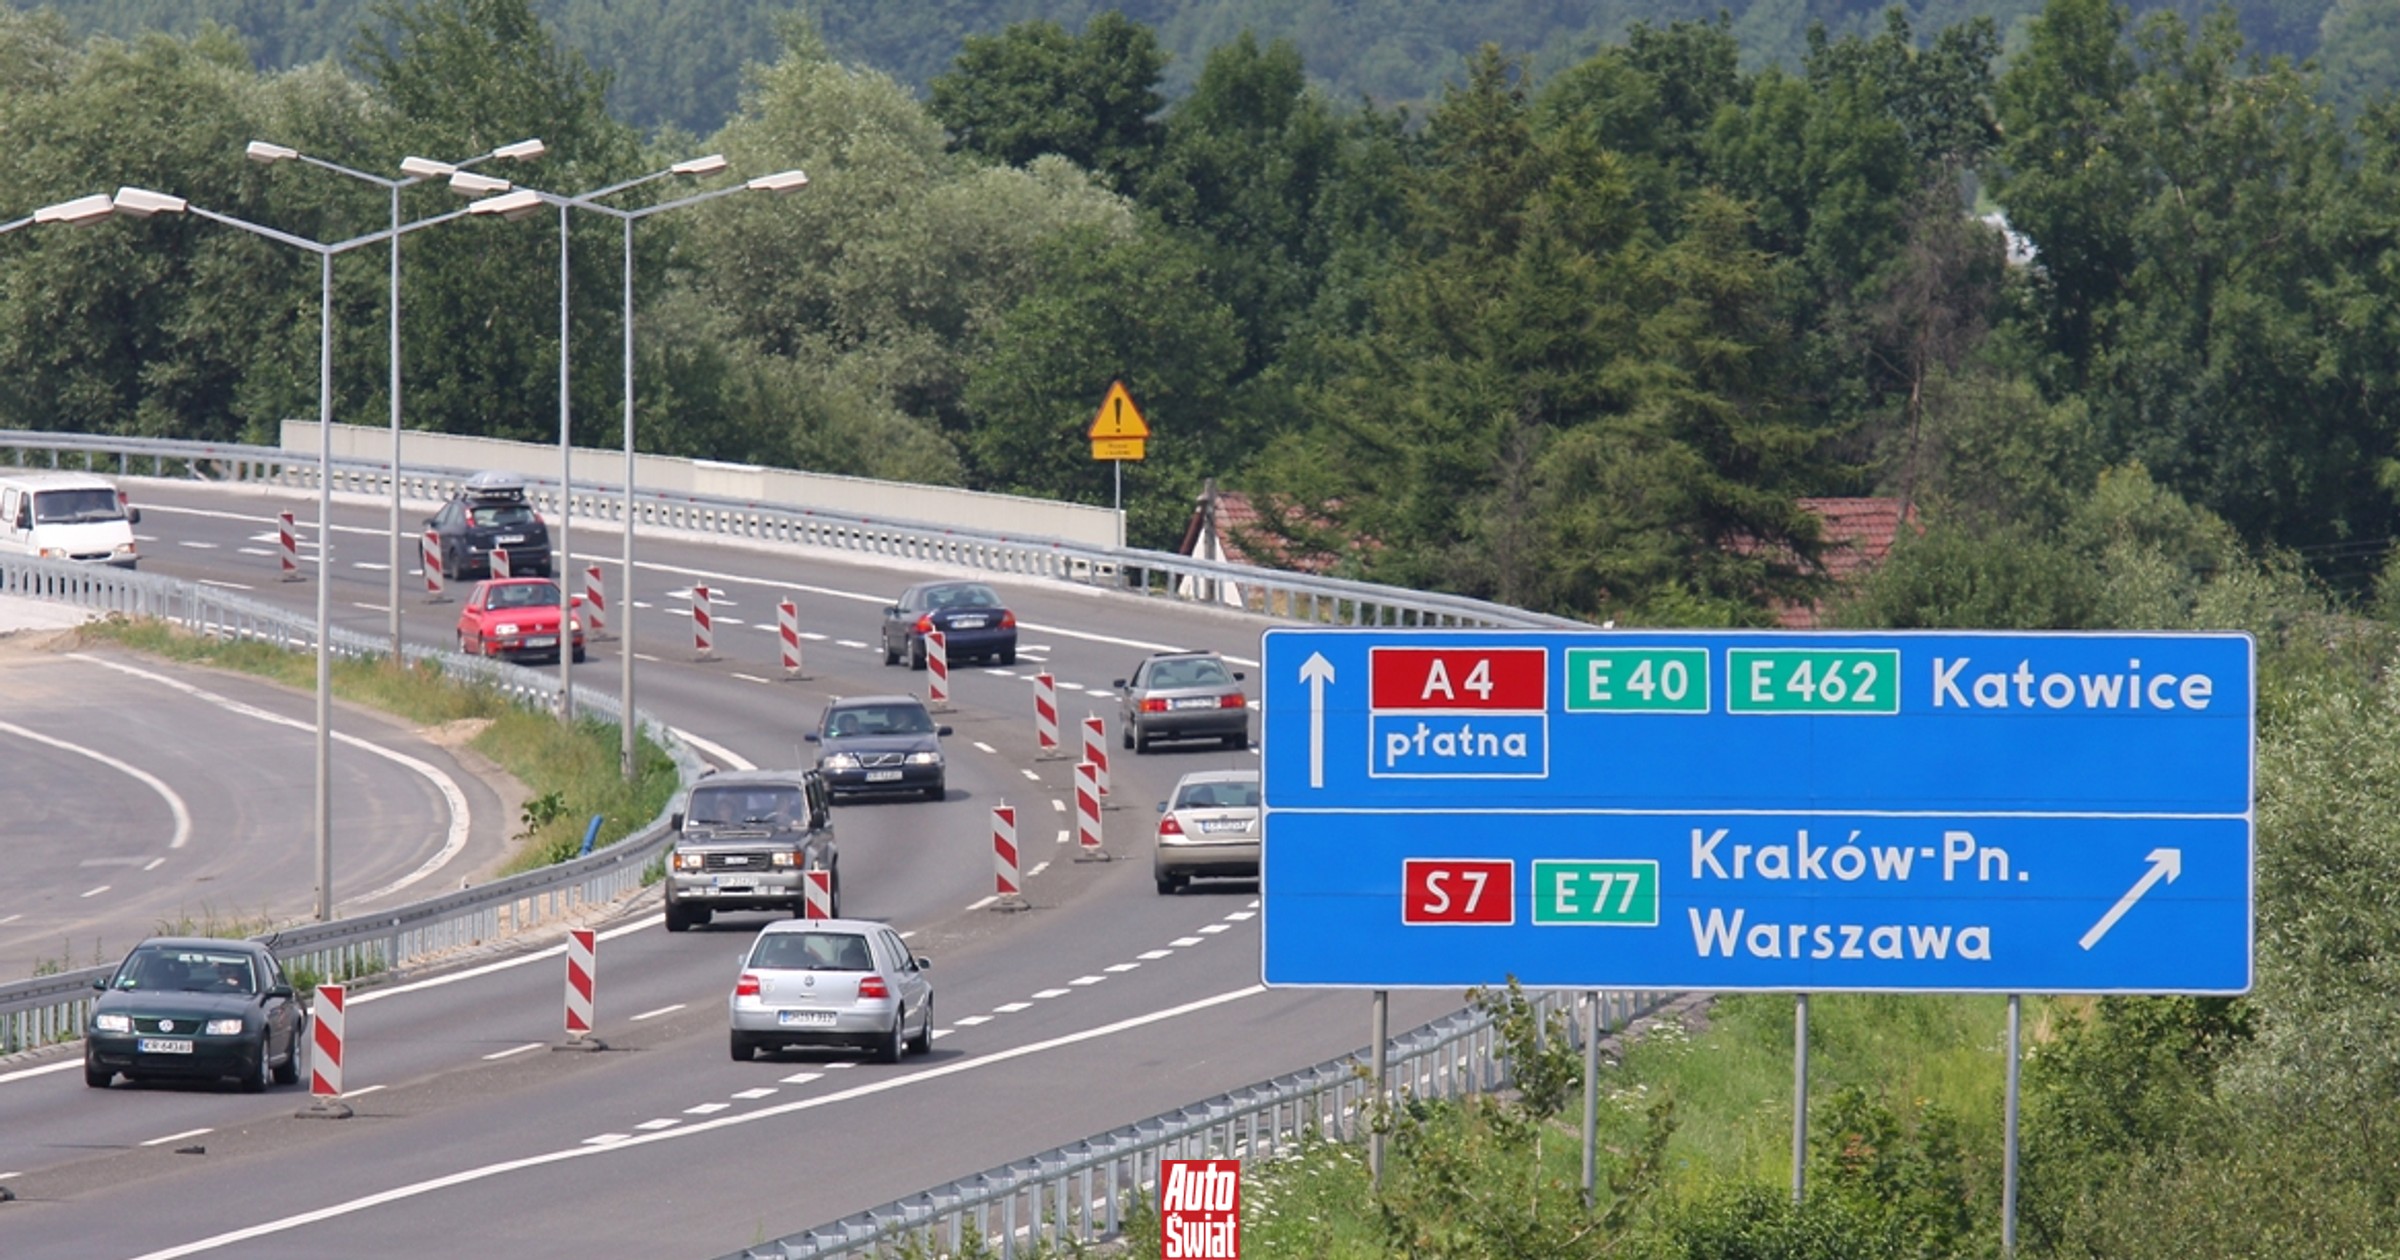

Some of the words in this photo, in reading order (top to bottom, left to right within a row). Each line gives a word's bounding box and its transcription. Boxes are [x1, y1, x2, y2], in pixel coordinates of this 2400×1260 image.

[1933, 657, 2212, 710] Katowice
[1386, 722, 1527, 767] płatna
[1691, 828, 2029, 881] Kraków-Pn.
[1688, 907, 1991, 960] Warszawa
